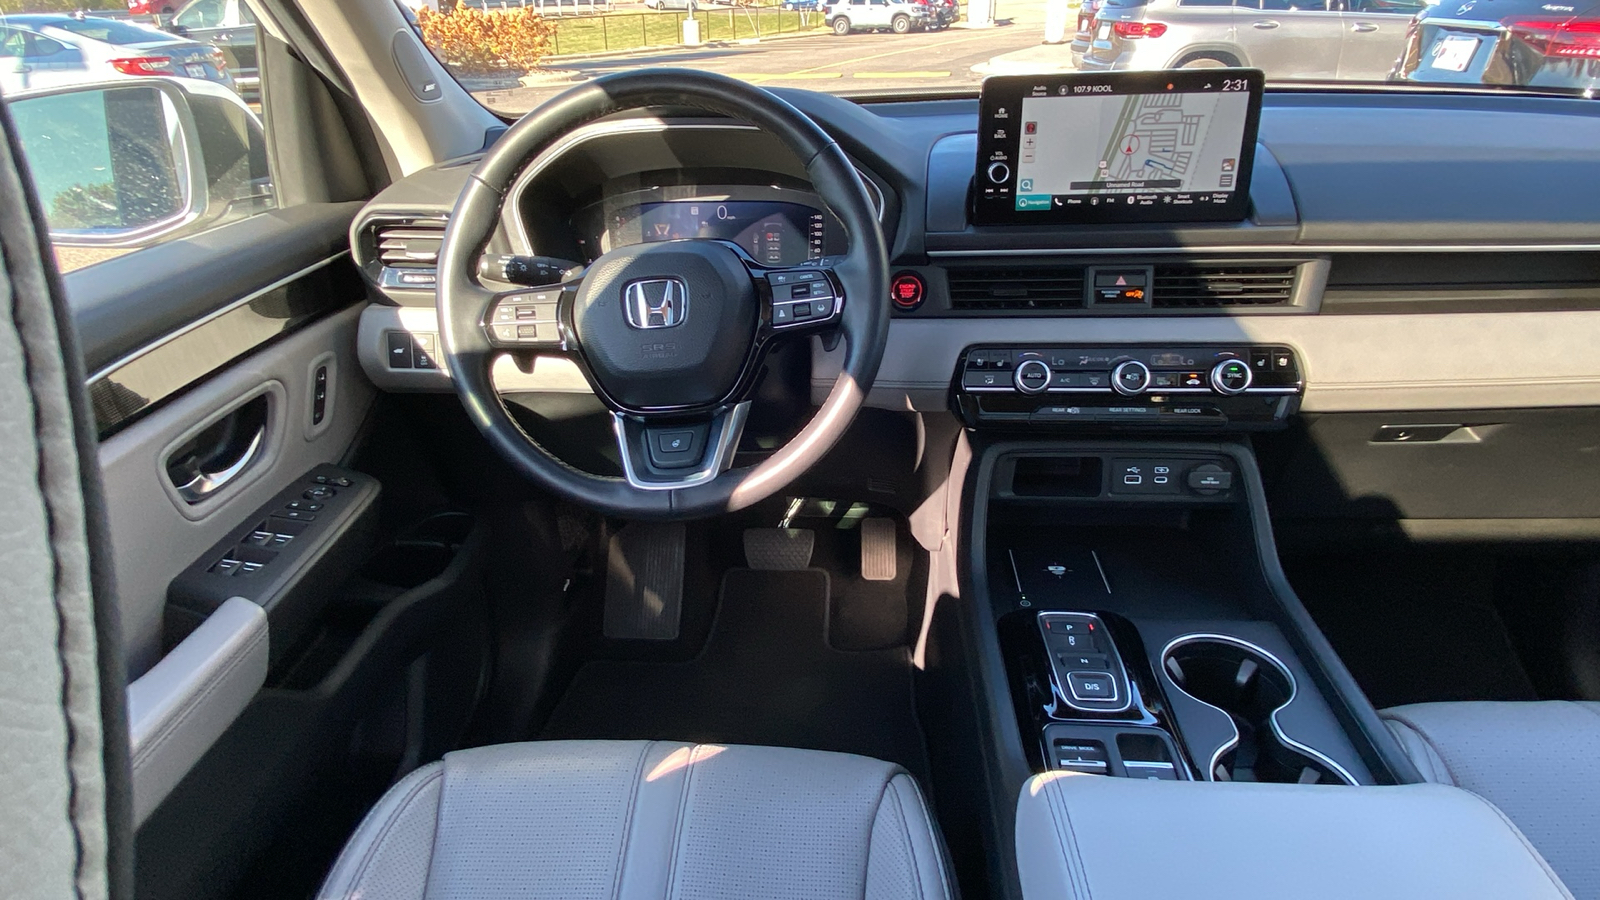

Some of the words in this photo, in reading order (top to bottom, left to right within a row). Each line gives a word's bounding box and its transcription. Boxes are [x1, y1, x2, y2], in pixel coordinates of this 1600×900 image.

[1073, 85, 1092, 93] 107.9
[1092, 85, 1113, 93] KOOL
[1222, 79, 1248, 91] 2:31
[717, 205, 728, 220] 0
[642, 342, 676, 352] SRS
[1052, 356, 1065, 366] Lo
[1085, 683, 1100, 691] D/S
